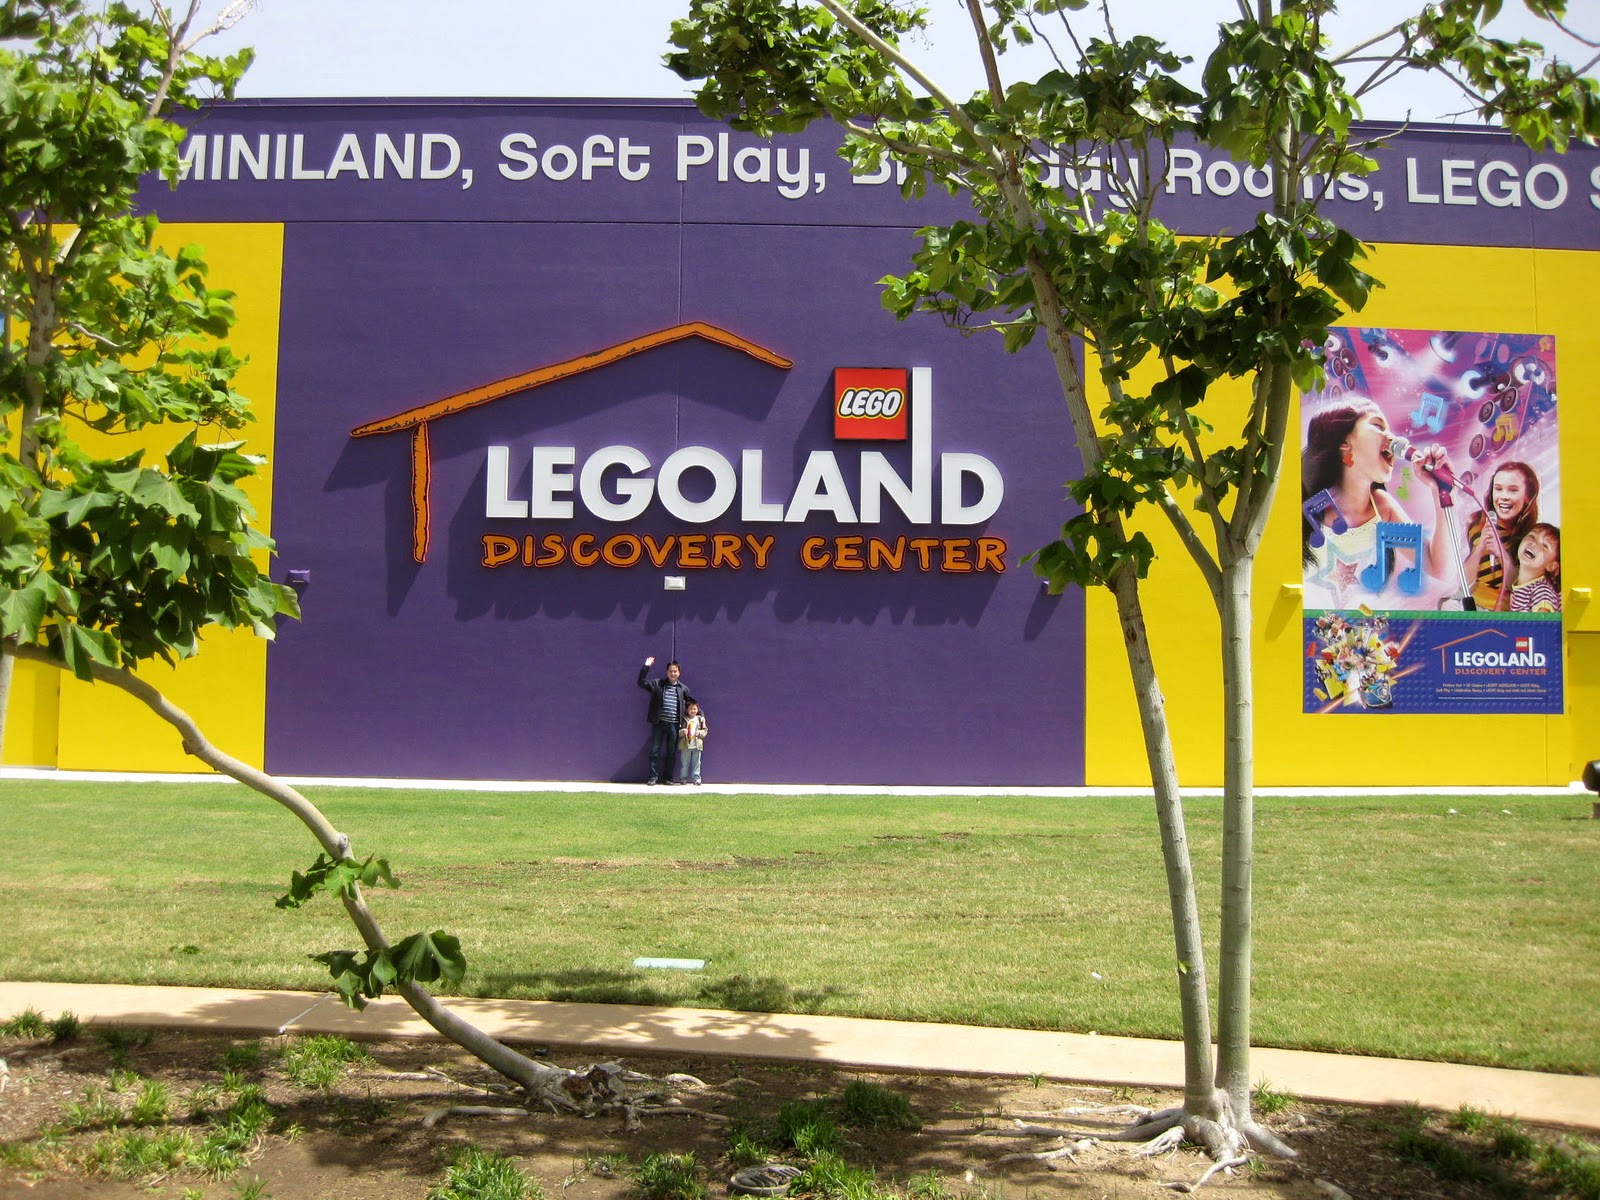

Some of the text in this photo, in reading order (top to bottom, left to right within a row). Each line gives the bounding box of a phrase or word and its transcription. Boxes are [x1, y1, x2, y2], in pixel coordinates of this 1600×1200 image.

[498, 132, 651, 181] Soft
[677, 132, 826, 200] Play,
[1406, 157, 1568, 211] LEGO
[836, 388, 905, 419] LEGO
[485, 366, 1005, 526] LEGOLAND
[481, 532, 1009, 574] DISCOVERY CENTER
[1454, 636, 1547, 667] LEGOLAND
[1455, 668, 1547, 676] DISCOVERY CENTER
